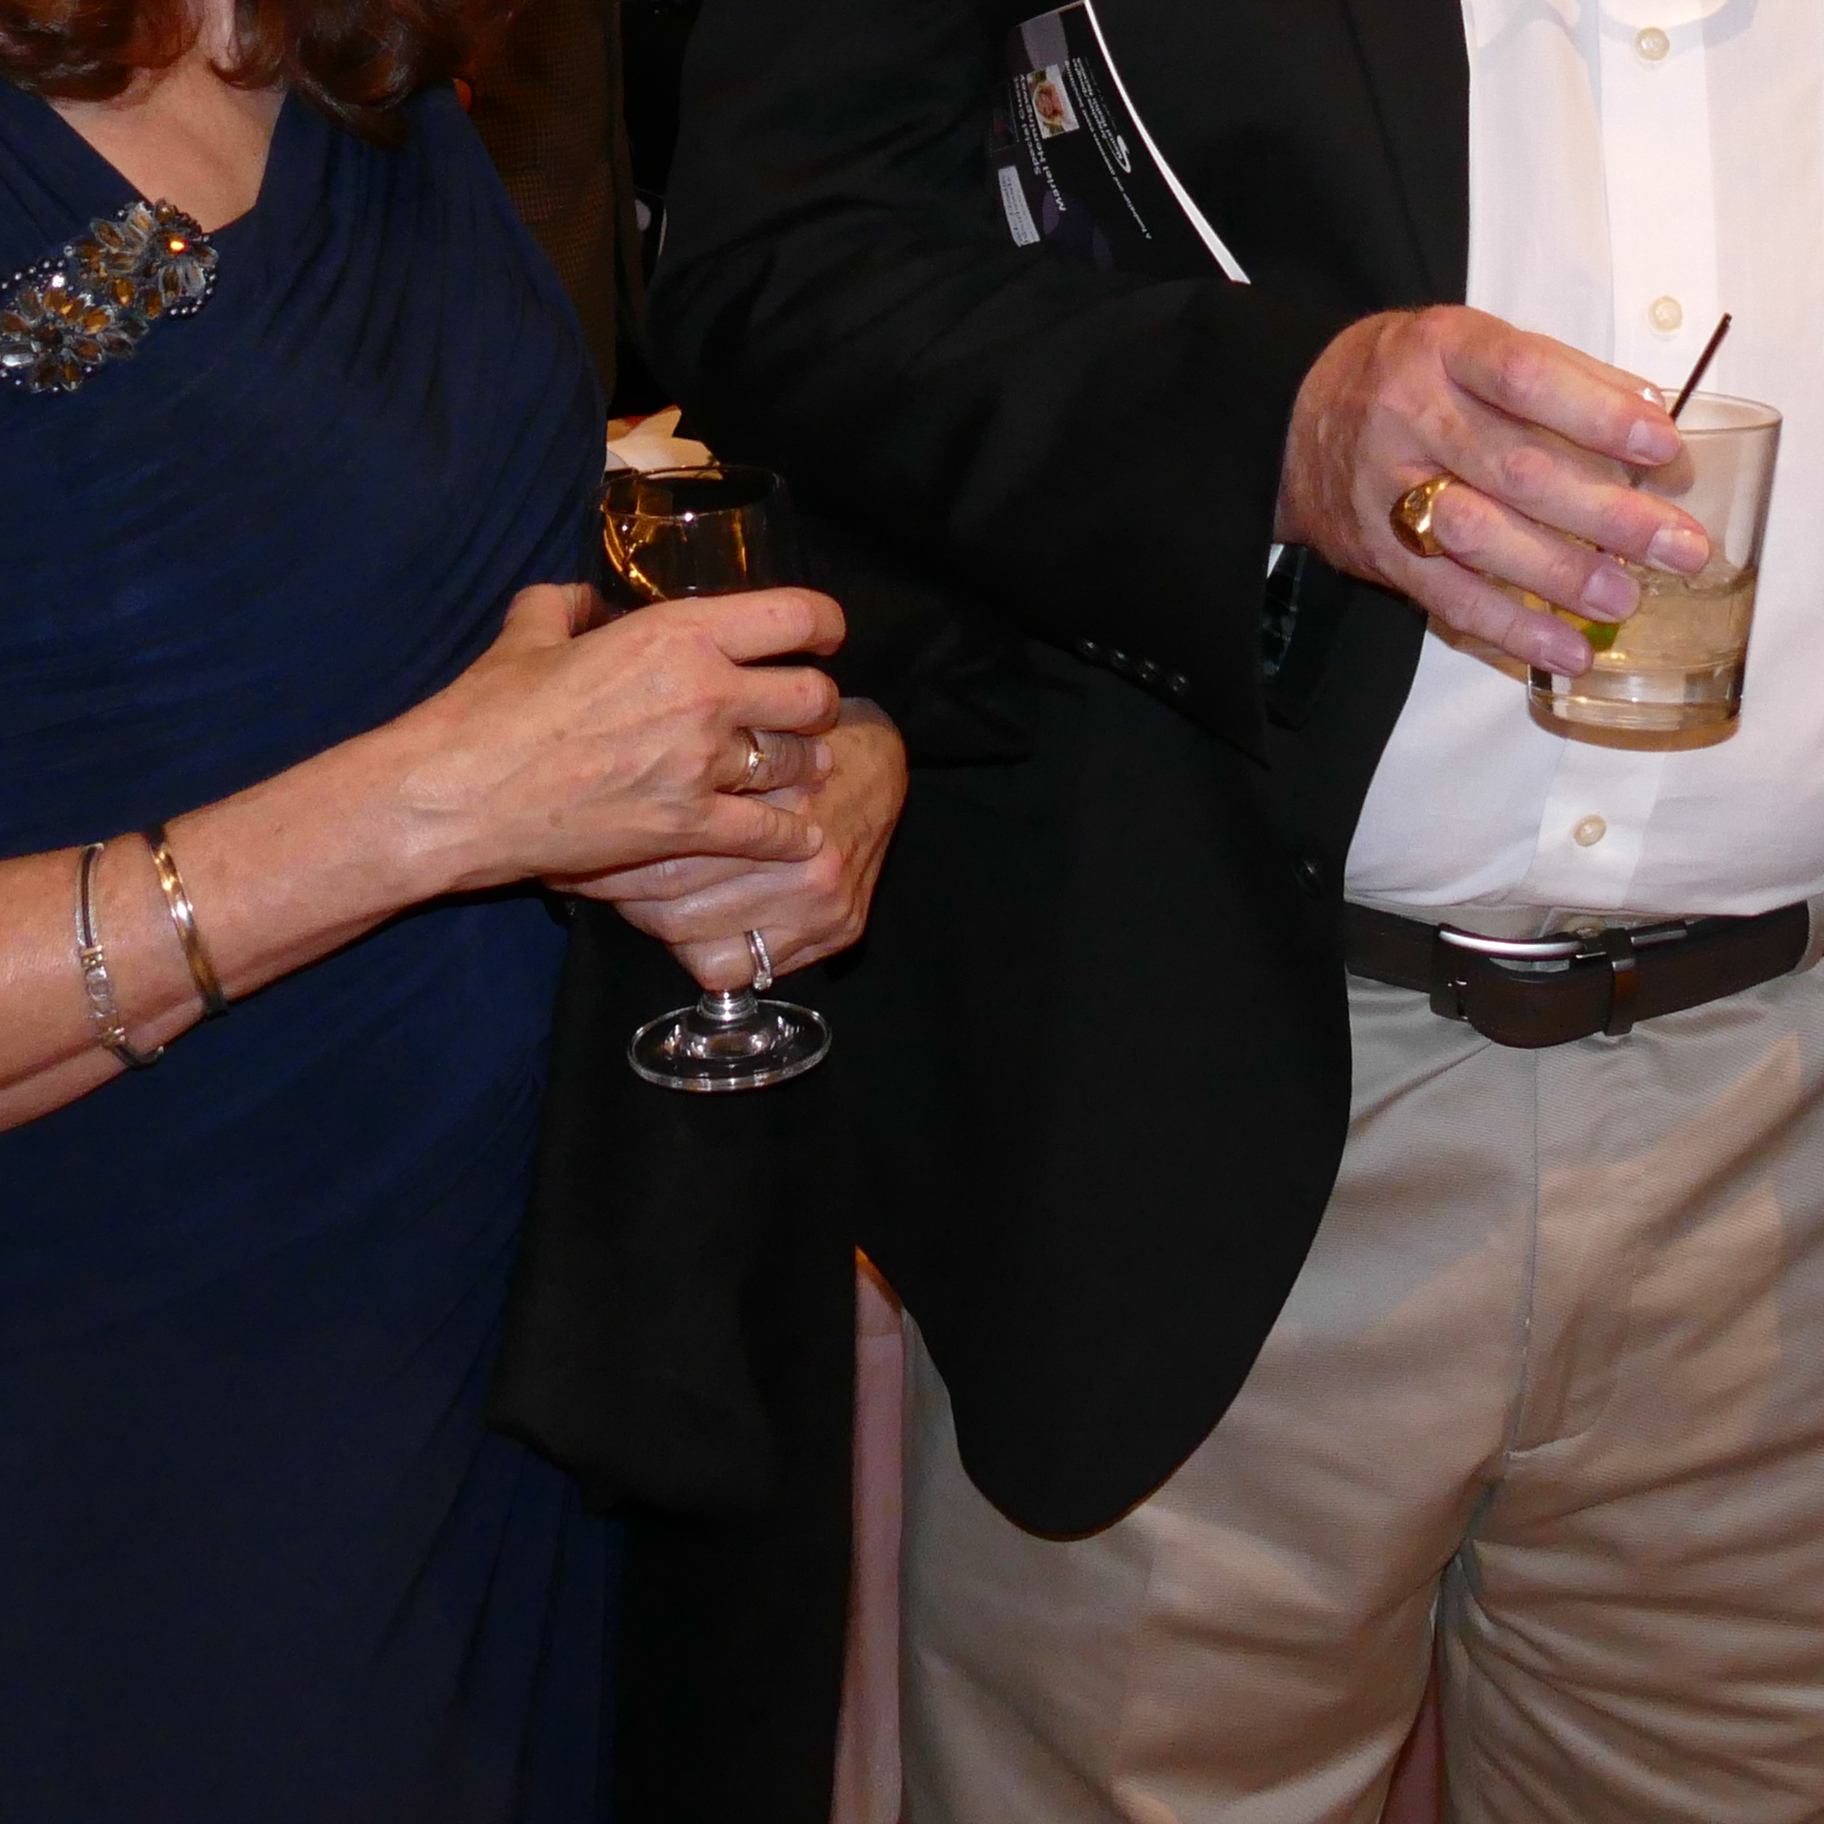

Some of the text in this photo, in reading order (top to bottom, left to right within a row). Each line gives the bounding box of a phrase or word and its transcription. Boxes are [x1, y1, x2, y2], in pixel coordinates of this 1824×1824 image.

[1018, 73, 1046, 163] Hemingway
[1020, 122, 1042, 175] Special
[1041, 165, 1067, 212] Mariel
